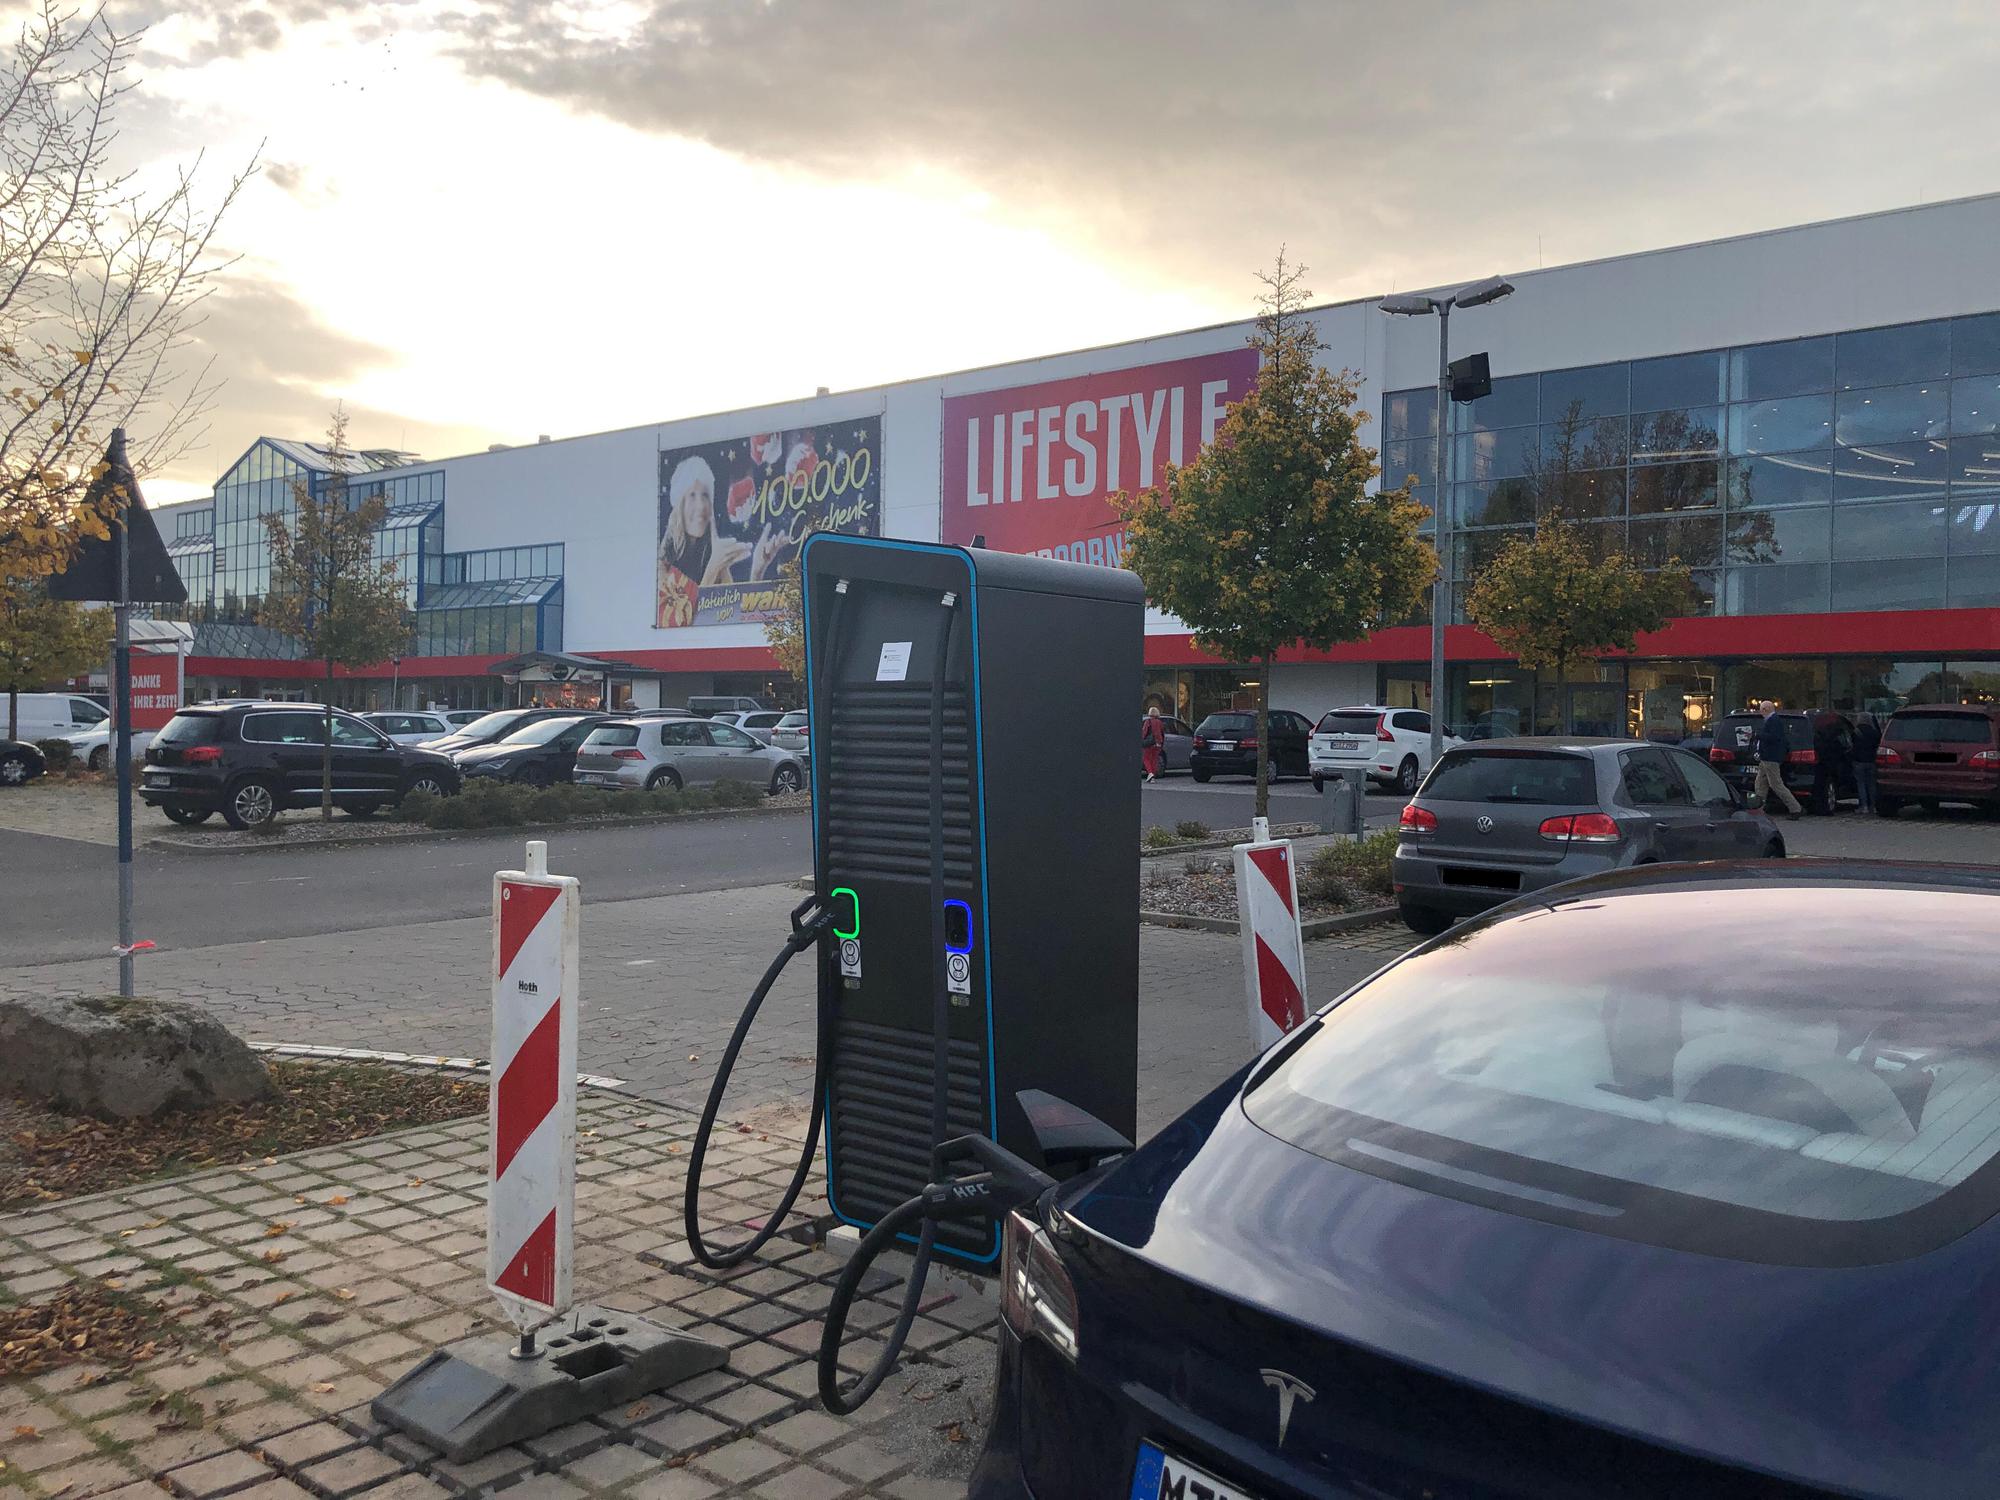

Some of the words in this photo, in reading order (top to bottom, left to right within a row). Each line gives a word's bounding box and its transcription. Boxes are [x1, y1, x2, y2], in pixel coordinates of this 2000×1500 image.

[752, 448, 871, 523] 100.000
[698, 588, 741, 612] natürlich
[131, 674, 161, 689] DANKE
[134, 694, 154, 709] IHRE
[156, 693, 177, 709] ZEIT!
[518, 980, 538, 992] Hoth
[952, 1183, 991, 1198] HPC
